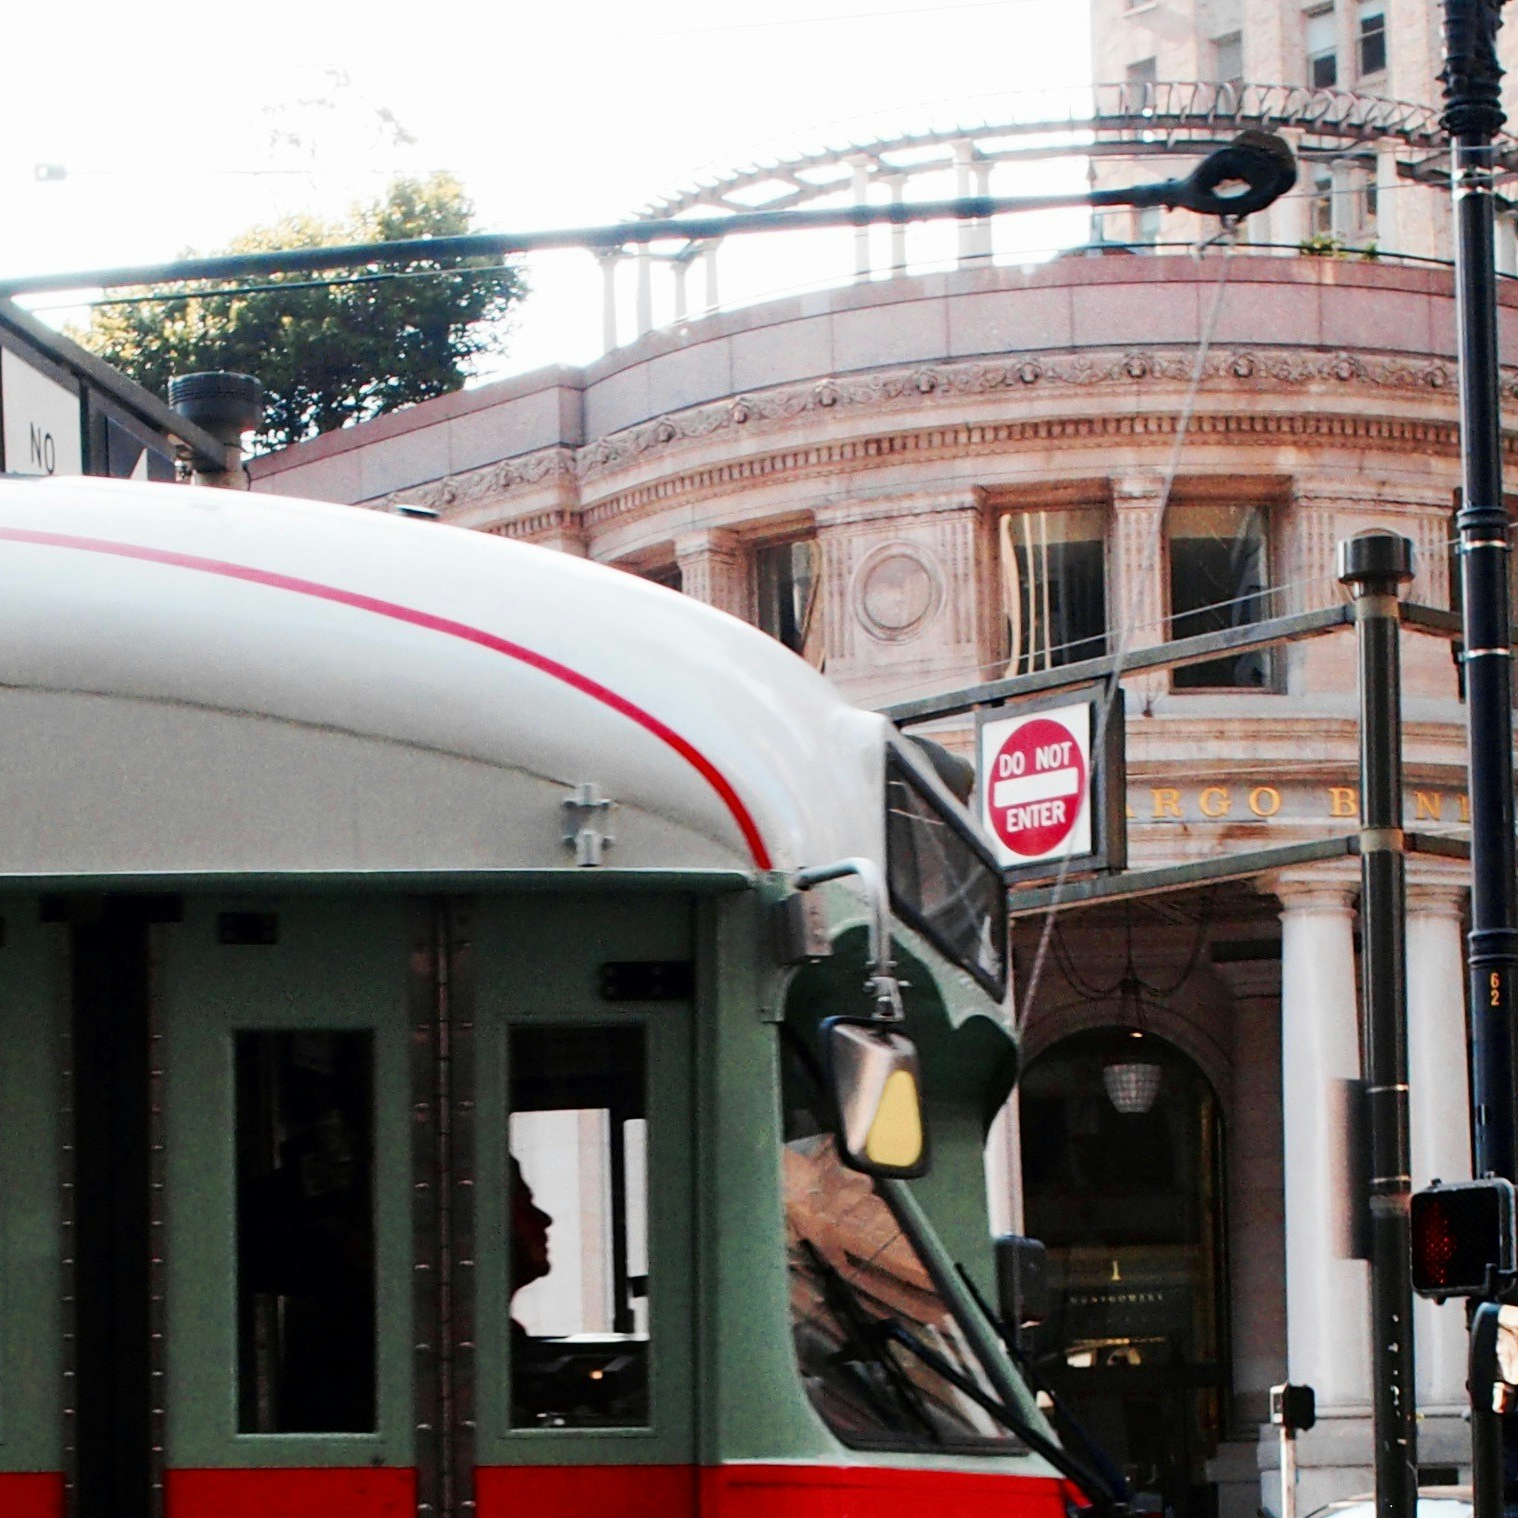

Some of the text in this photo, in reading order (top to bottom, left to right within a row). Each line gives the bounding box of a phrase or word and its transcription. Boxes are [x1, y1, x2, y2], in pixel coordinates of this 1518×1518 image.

[29, 421, 56, 475] NO
[998, 741, 1073, 779] DO NOT
[1005, 801, 1067, 833] ENTER
[1126, 785, 1282, 819] RGO
